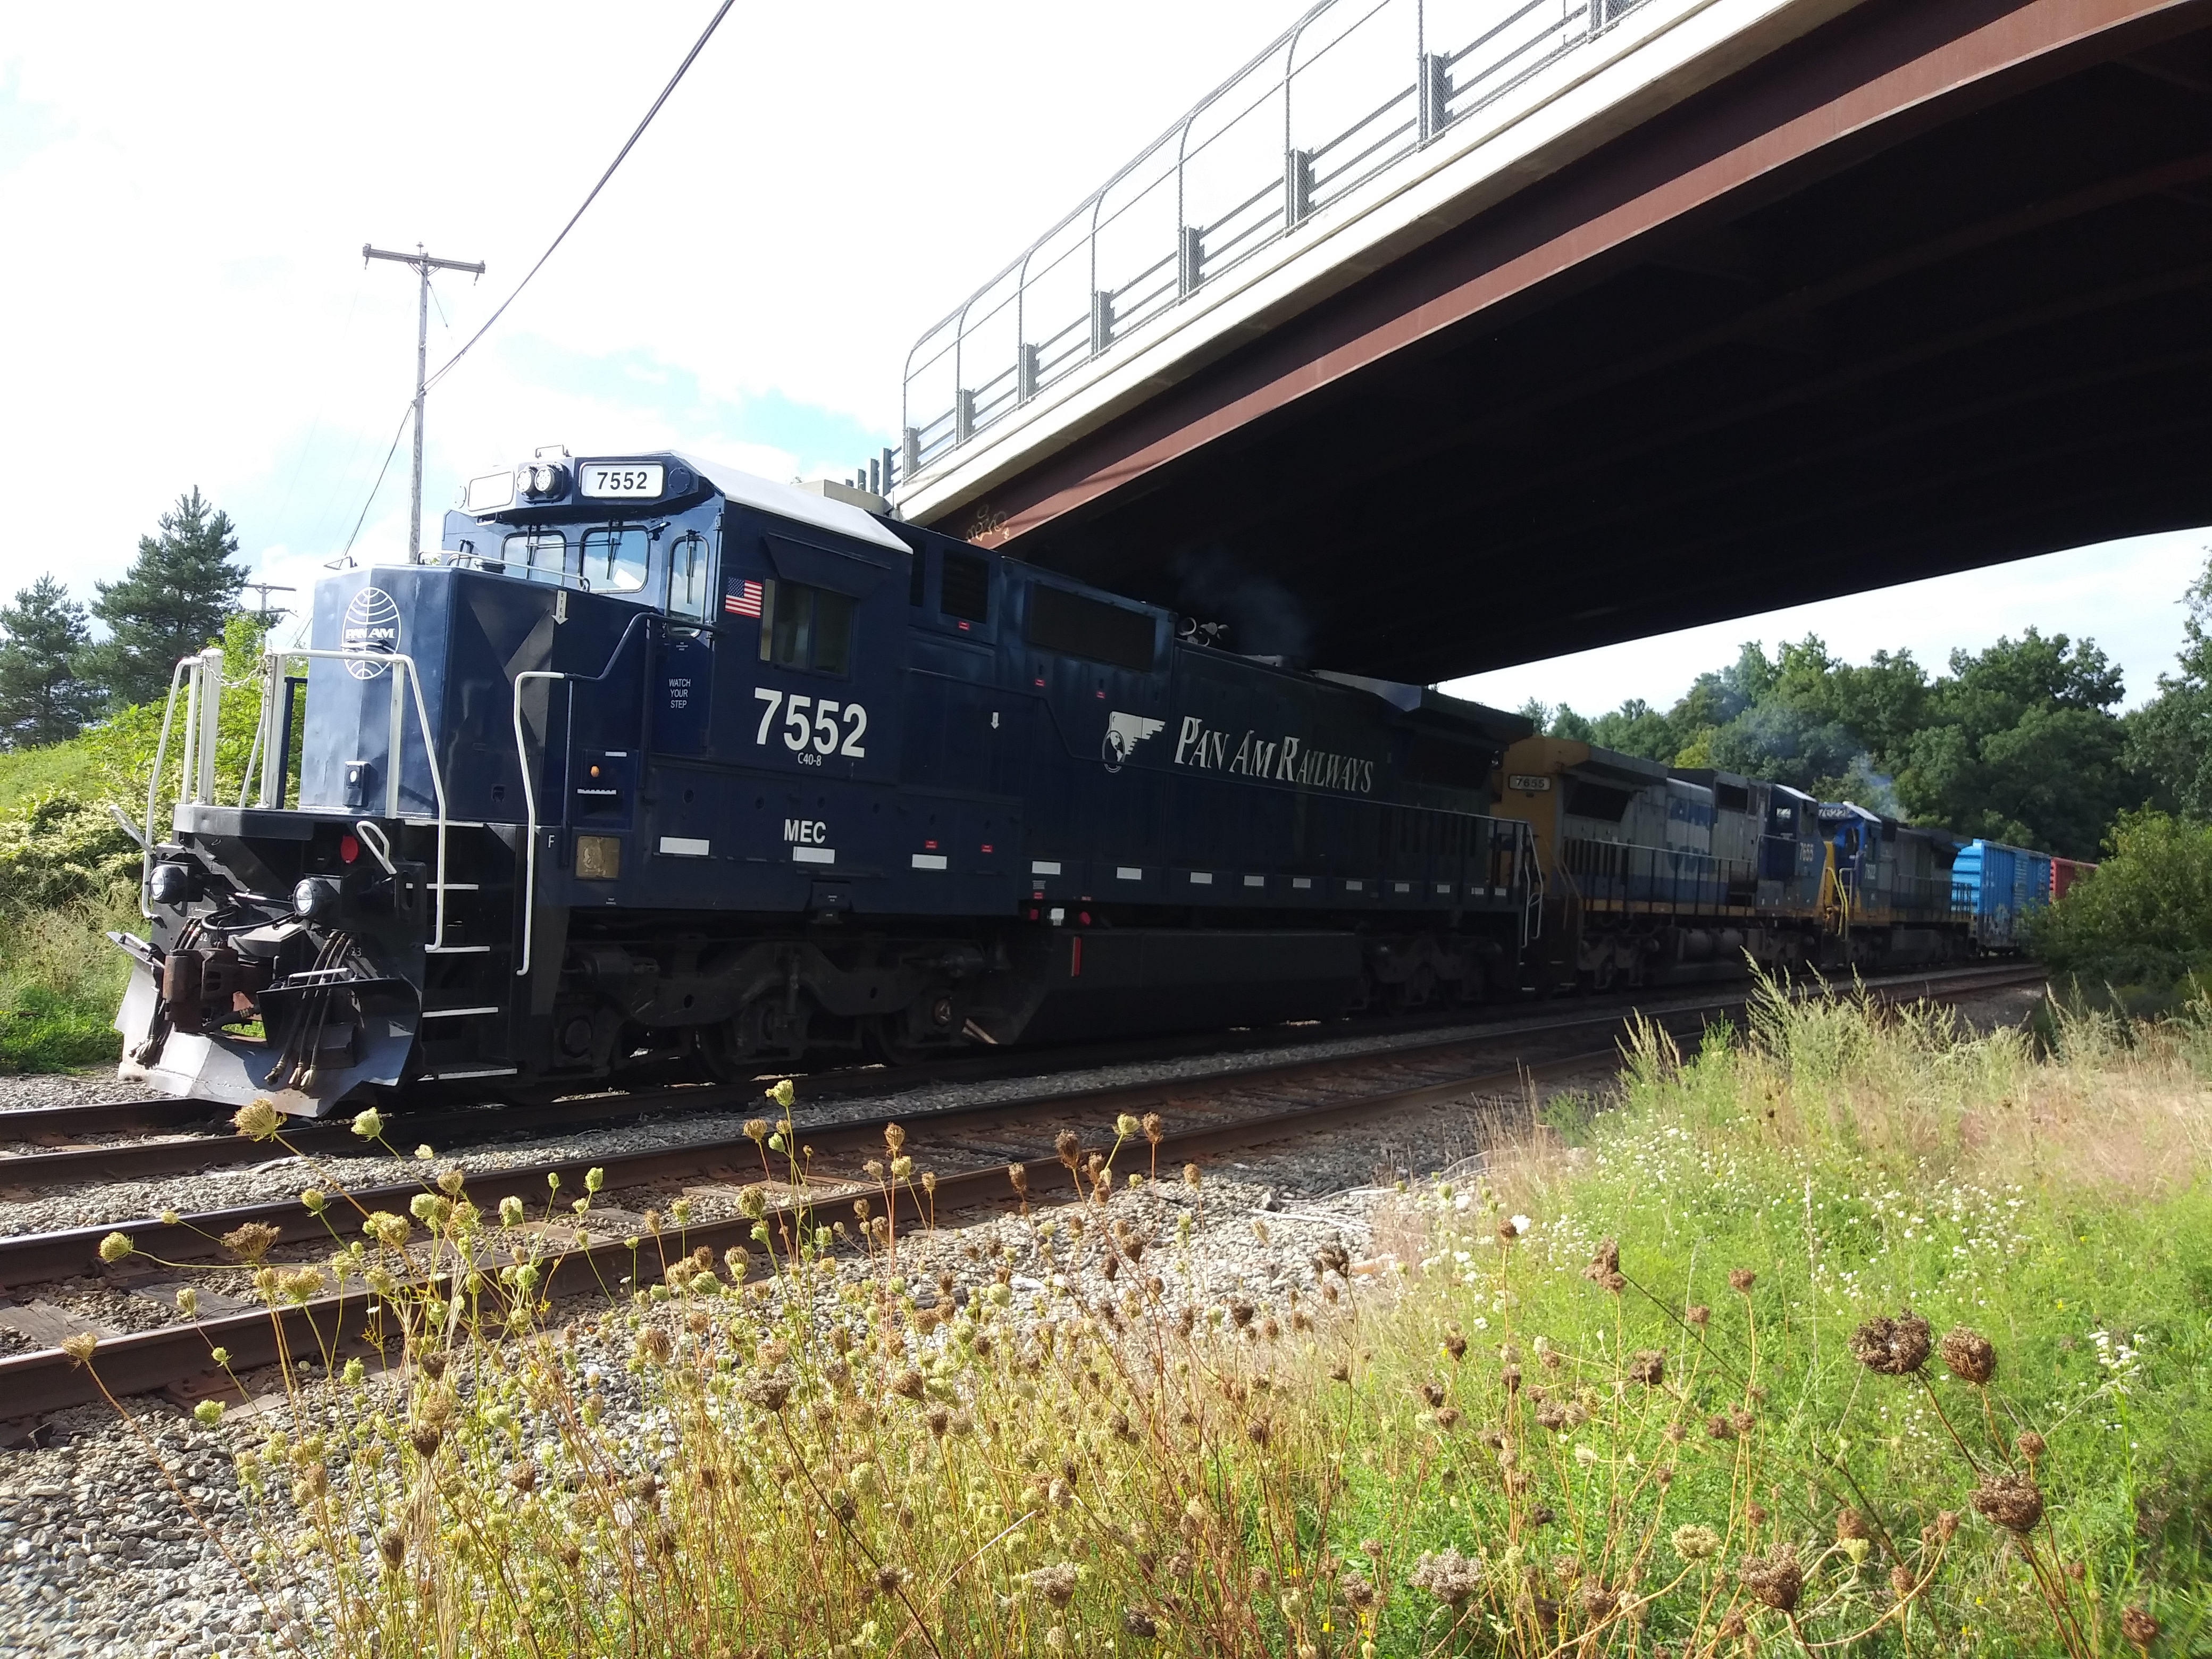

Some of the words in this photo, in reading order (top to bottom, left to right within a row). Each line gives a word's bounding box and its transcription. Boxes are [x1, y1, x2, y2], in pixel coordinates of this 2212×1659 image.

[597, 471, 648, 490] 7552
[345, 628, 368, 639] PAN
[367, 628, 396, 639] AM
[668, 678, 691, 687] WATCH
[670, 689, 689, 698] YOUR
[670, 700, 688, 709] STEP
[754, 686, 867, 758] 7552
[797, 752, 822, 767] C40-8
[1174, 715, 1230, 770] PAN
[1228, 730, 1277, 779] AM
[1275, 735, 1373, 793] RAILWAYS
[1516, 778, 1545, 788] 7655
[784, 818, 827, 844] MEC
[548, 834, 555, 848] F
